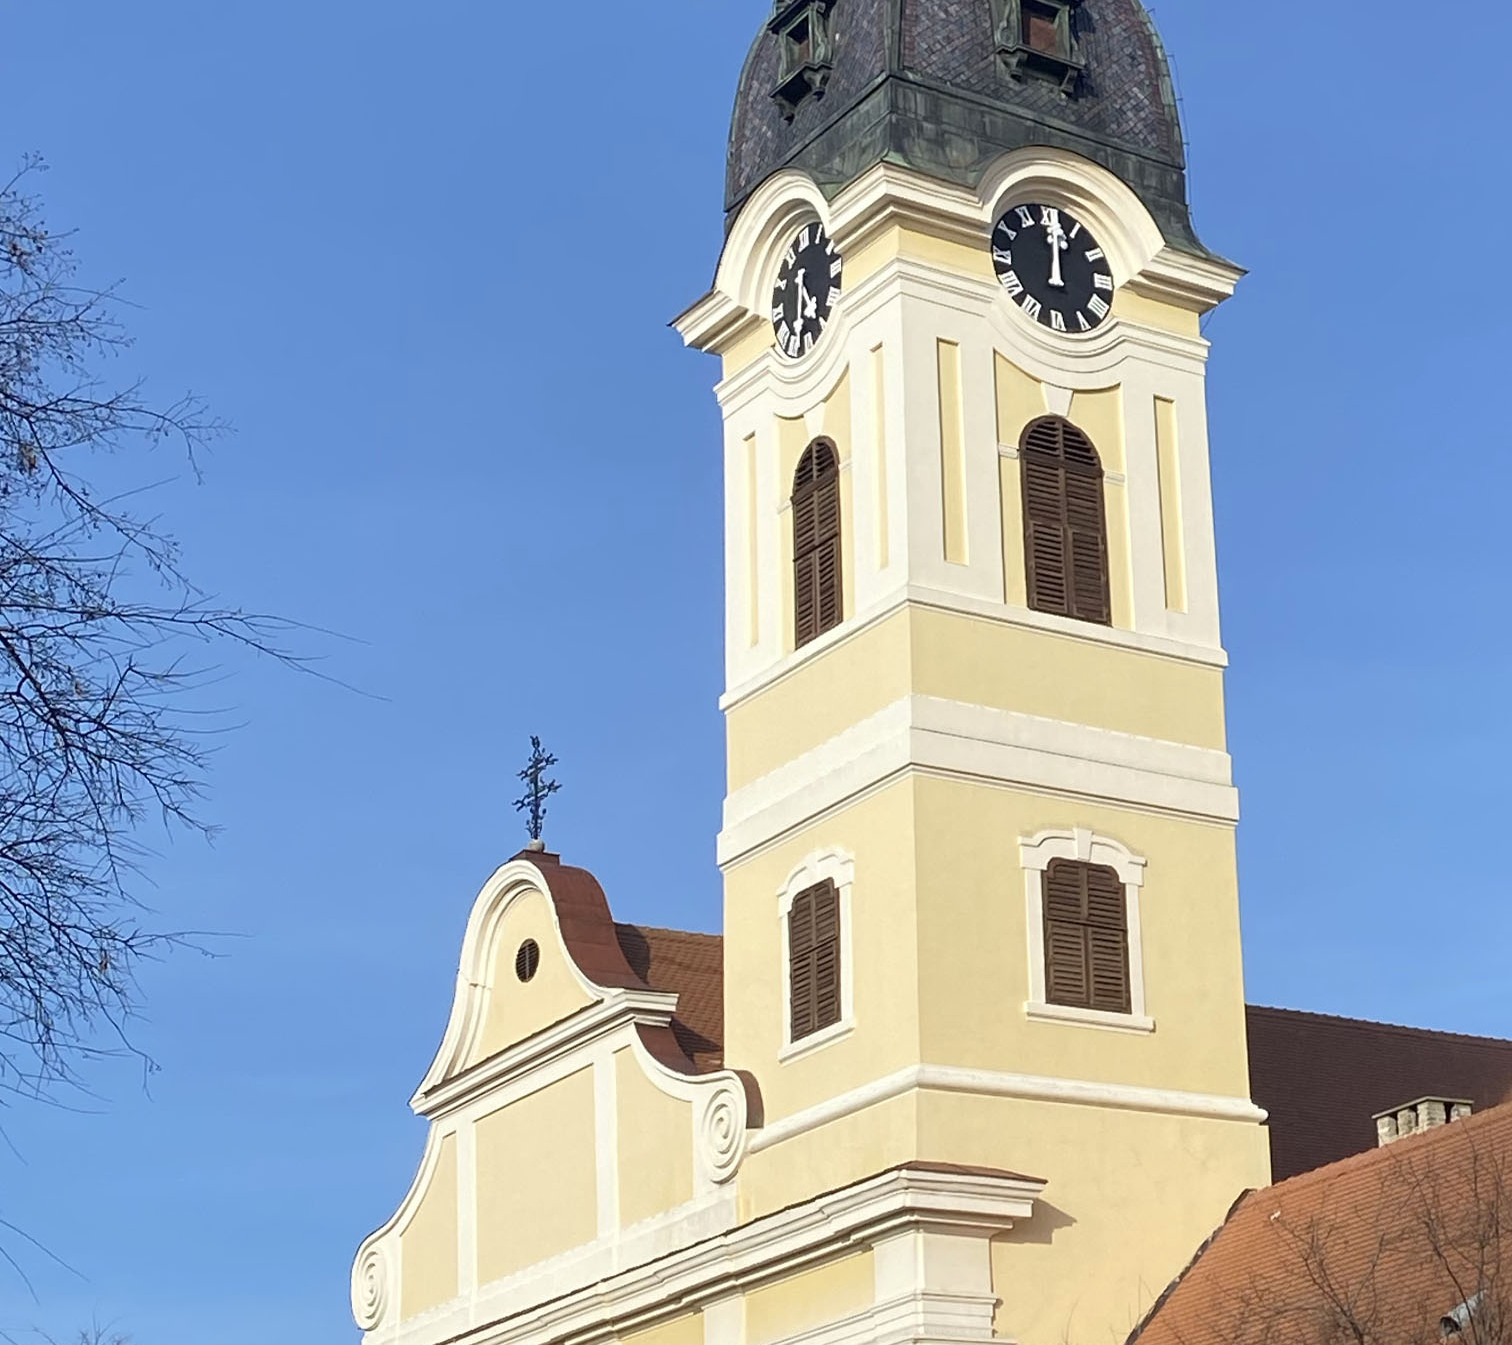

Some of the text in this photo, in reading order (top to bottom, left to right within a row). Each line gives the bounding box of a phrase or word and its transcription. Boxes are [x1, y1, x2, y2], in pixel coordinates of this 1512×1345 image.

[1015, 205, 1035, 228] XI
[998, 220, 1017, 240] X
[1069, 222, 1081, 239] I
[993, 245, 1012, 265] IX
[1085, 247, 1104, 262] II
[830, 257, 841, 279] III
[998, 270, 1024, 296] VIII
[1093, 273, 1113, 291] III
[1021, 294, 1042, 321] VII
[1087, 293, 1110, 320] IIII
[1050, 310, 1067, 331] VI
[1076, 311, 1091, 331] V
